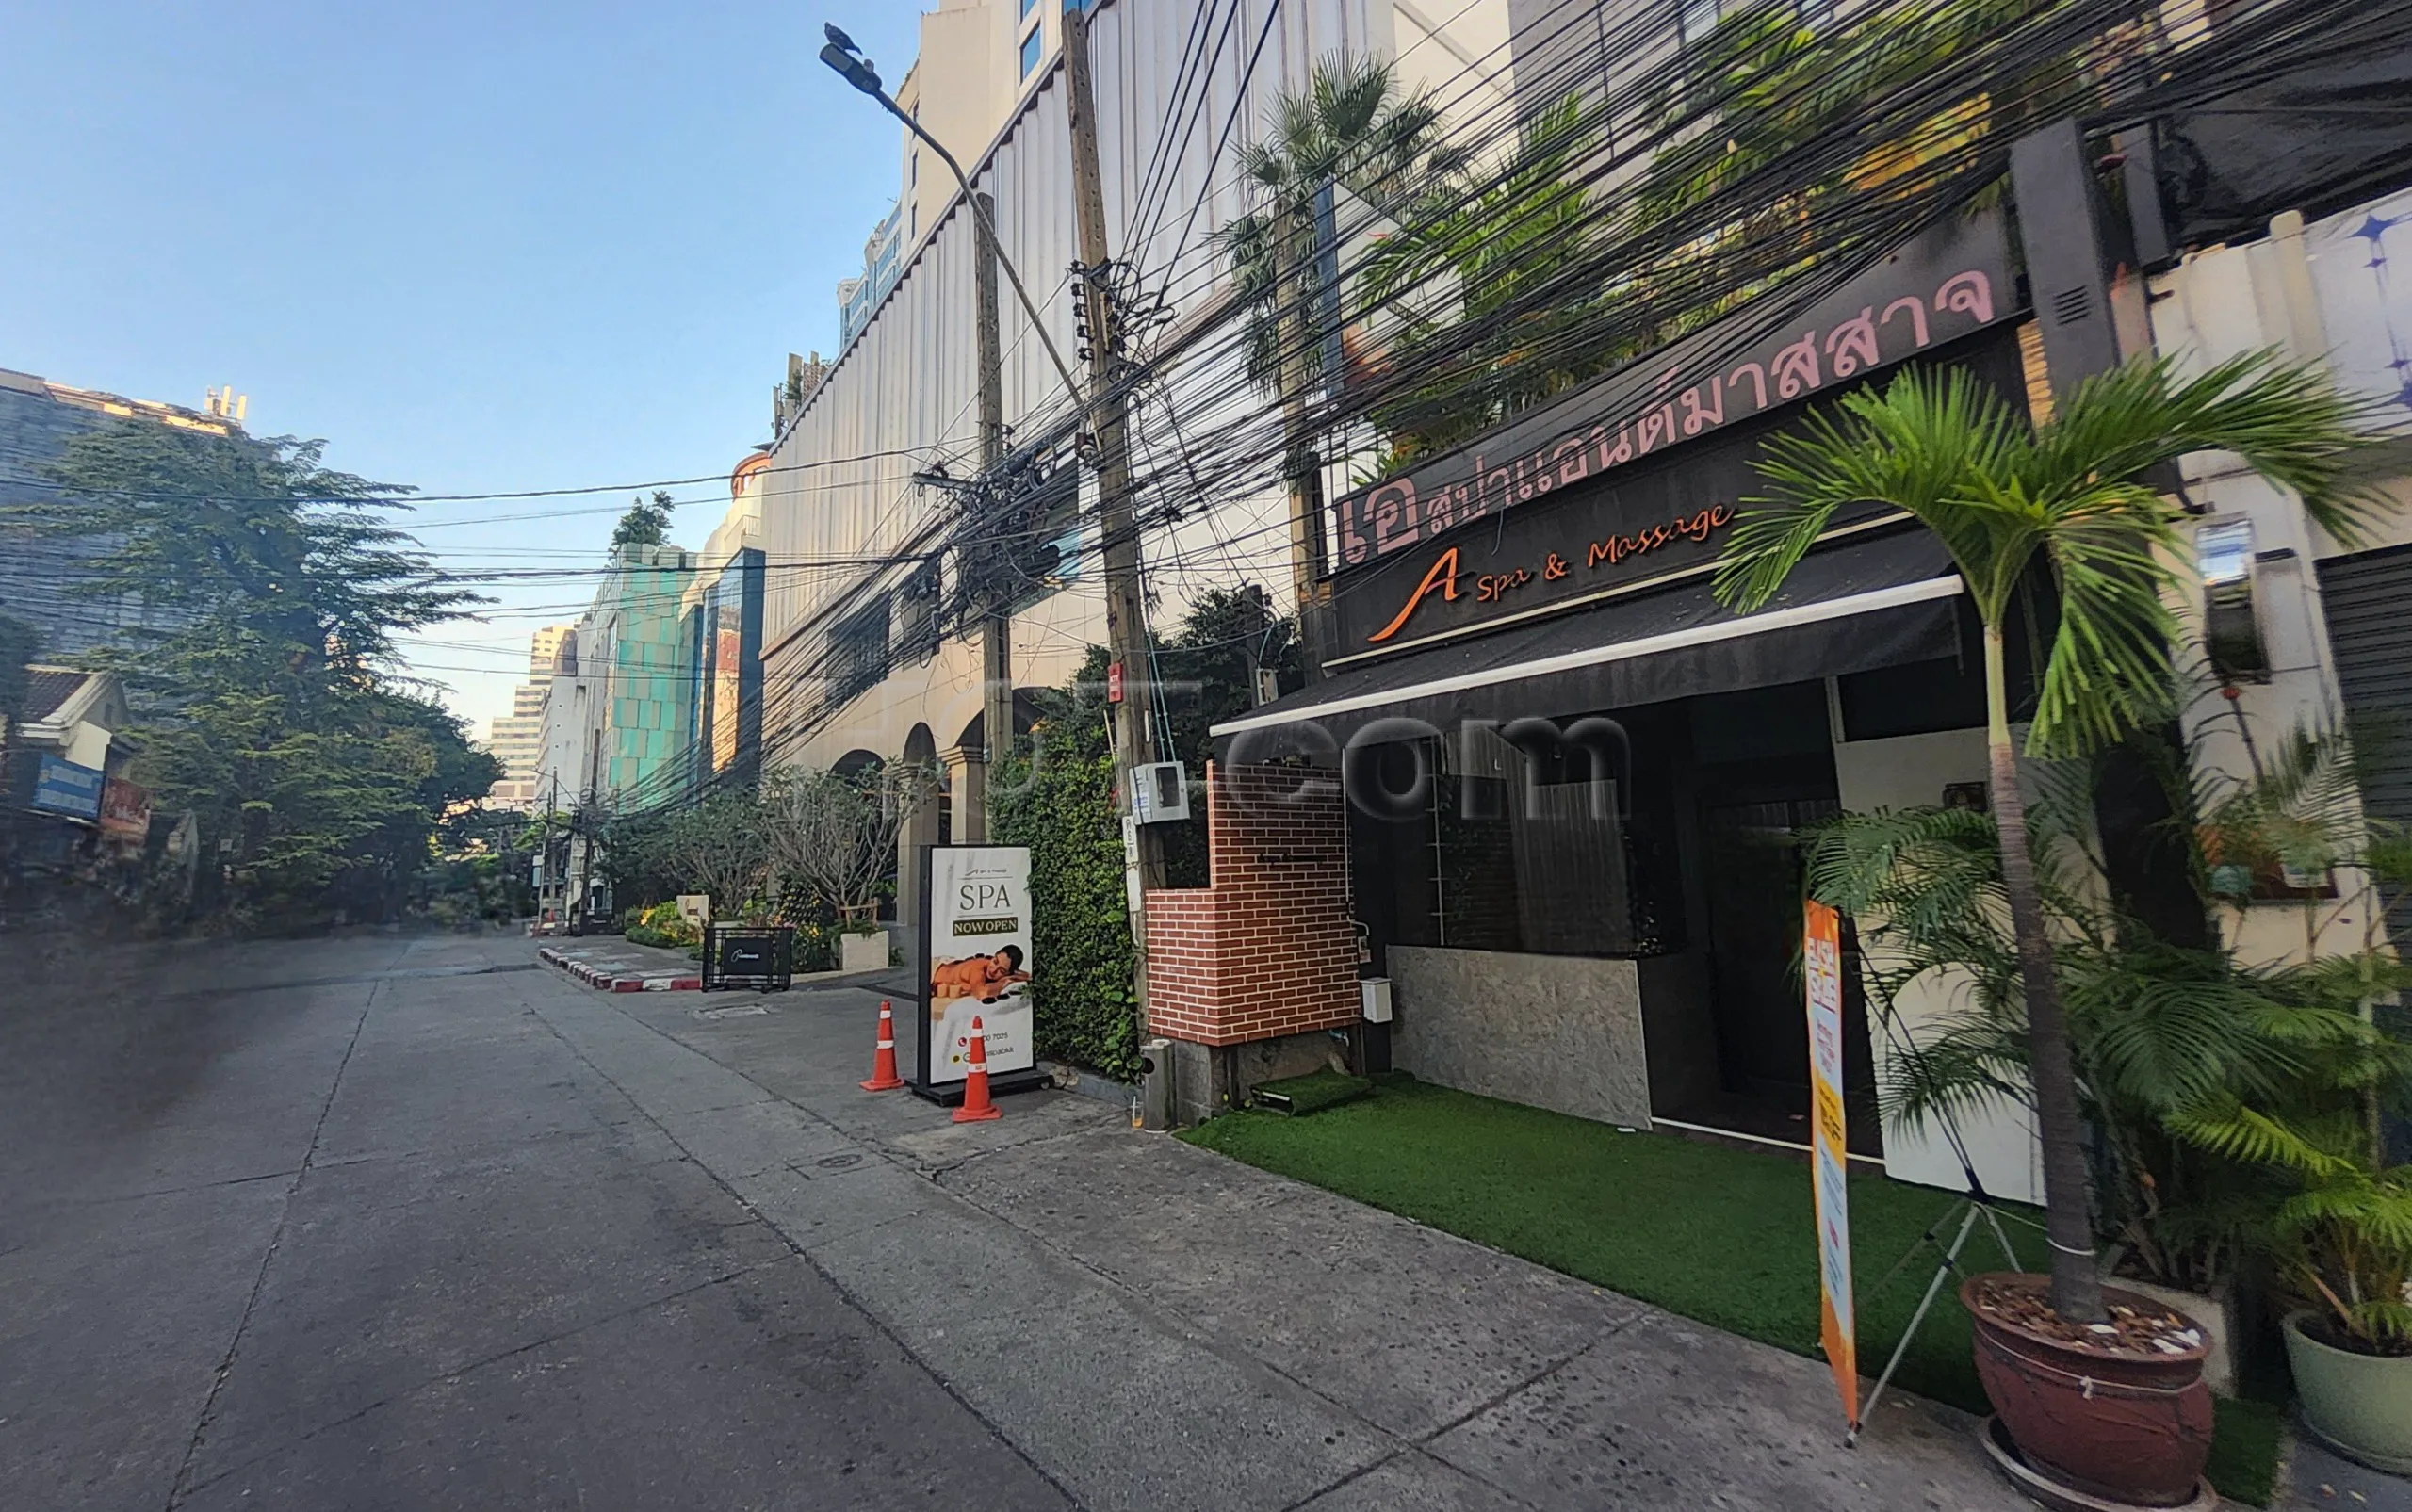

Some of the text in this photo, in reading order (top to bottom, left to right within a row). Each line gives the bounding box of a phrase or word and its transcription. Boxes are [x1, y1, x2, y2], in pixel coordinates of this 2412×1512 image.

[1366, 505, 1734, 642] A Spa & Massage
[959, 884, 1011, 910] SPA
[953, 919, 1017, 934] NOW OPEN
